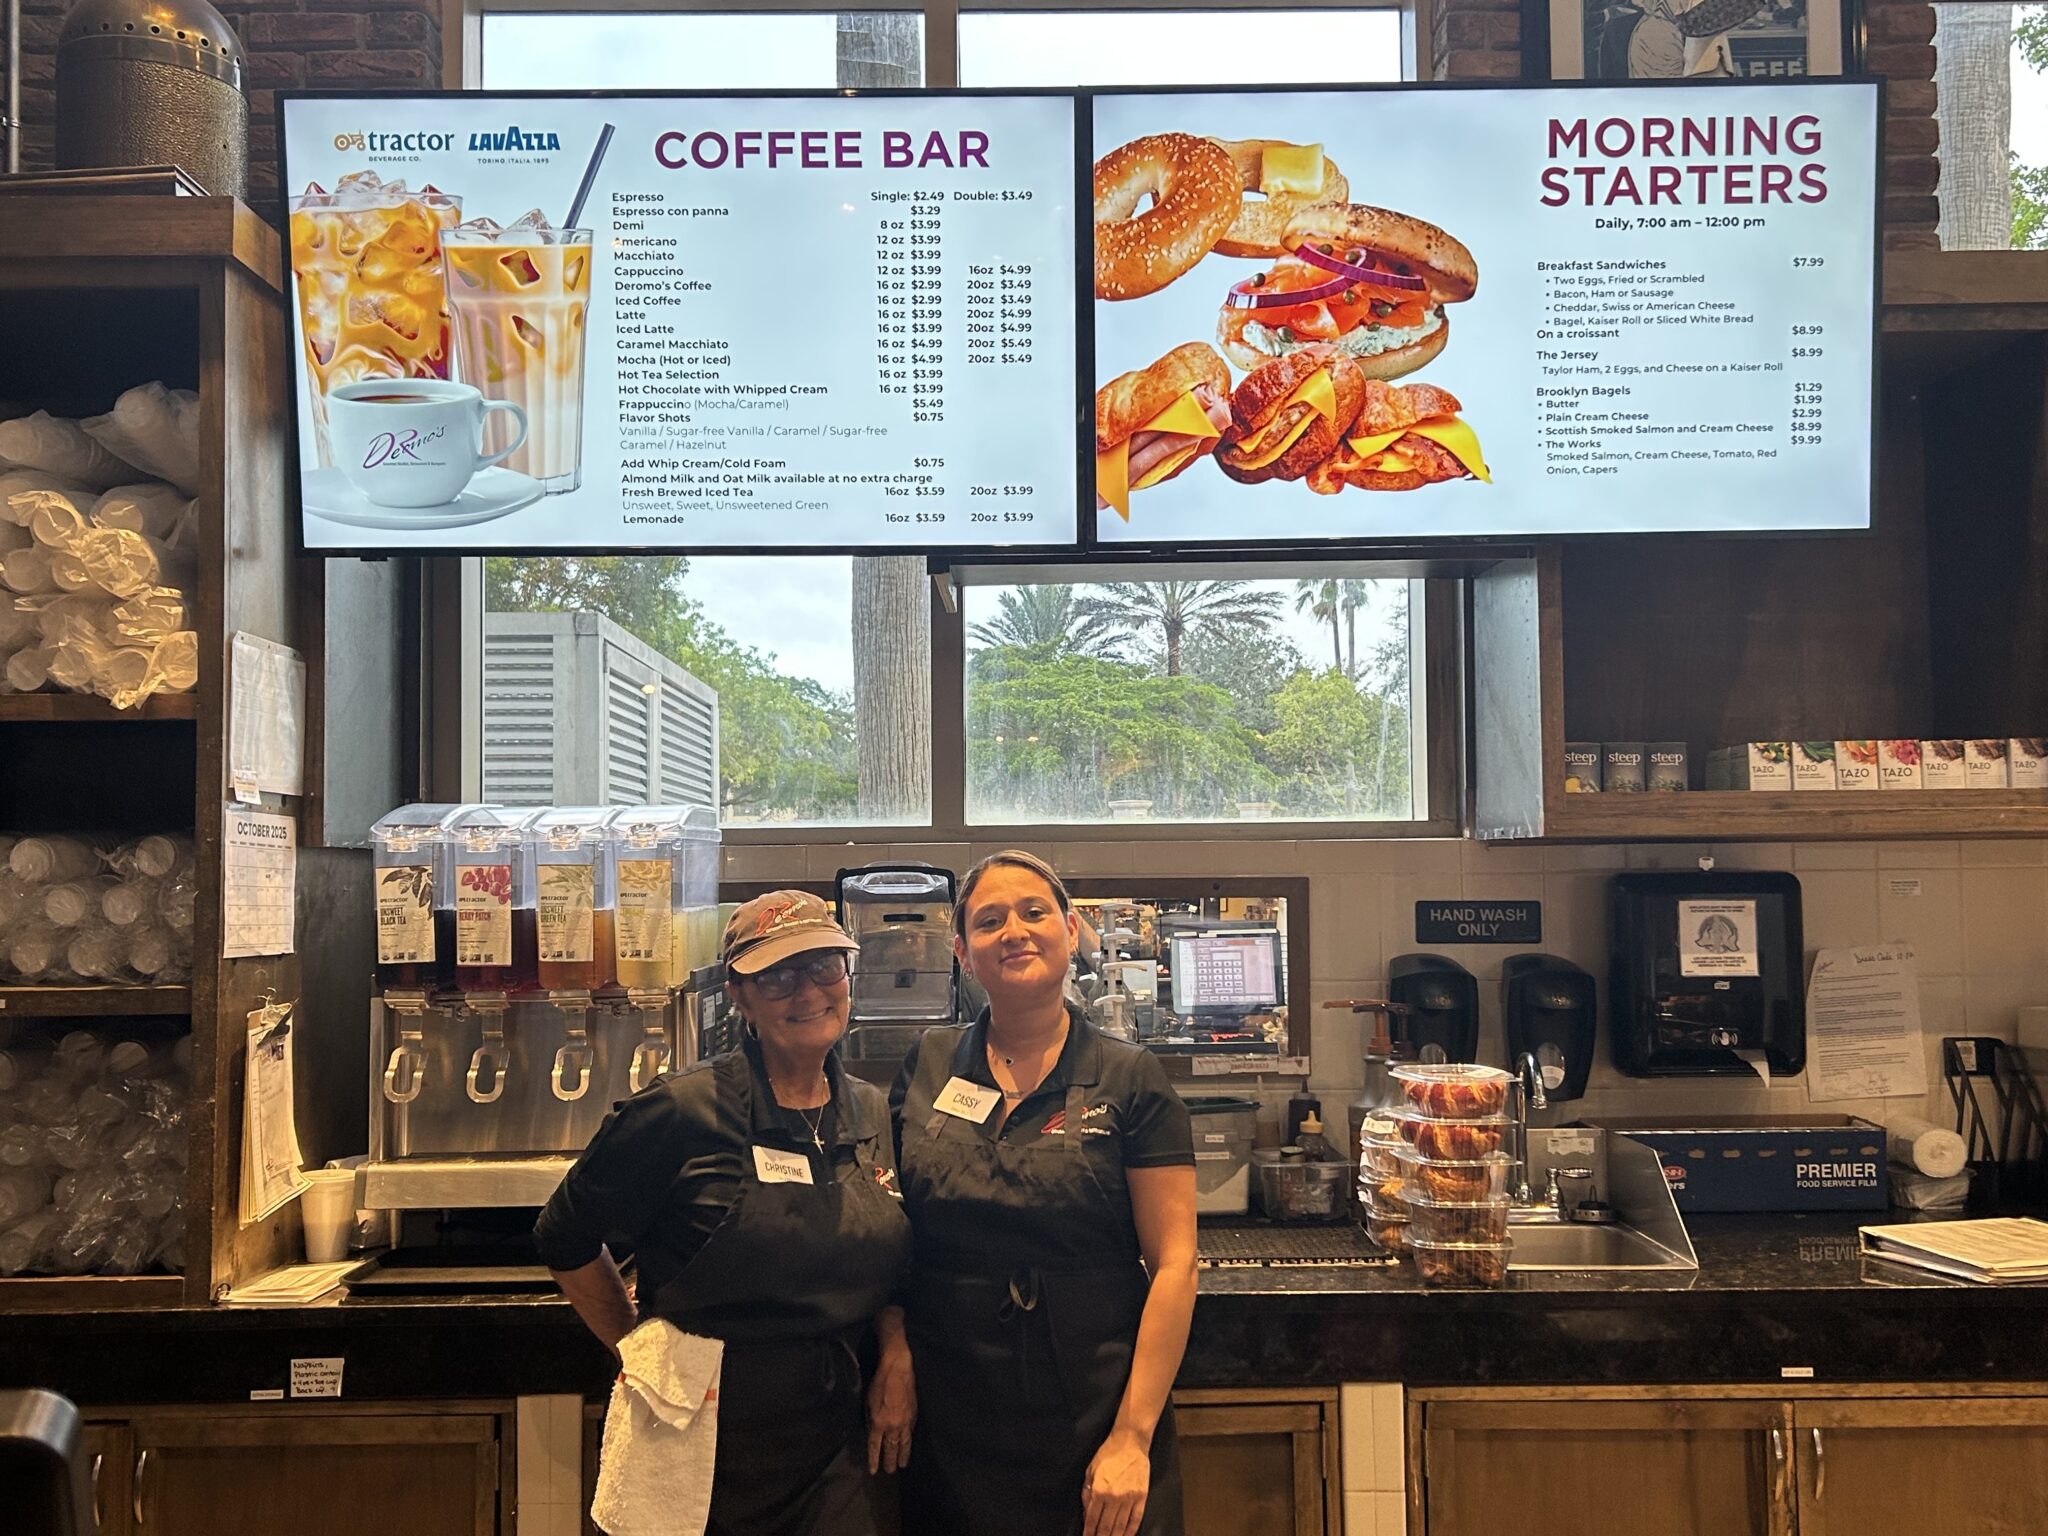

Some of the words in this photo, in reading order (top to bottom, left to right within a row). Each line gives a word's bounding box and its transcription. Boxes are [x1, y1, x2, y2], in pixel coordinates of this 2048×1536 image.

[367, 130, 455, 152] tractor
[468, 126, 561, 151] LAVAZZA
[1548, 115, 1822, 158] MORNING
[655, 131, 862, 169] COFFEE
[883, 131, 990, 168] BAR
[1539, 163, 1828, 207] STARTERS
[613, 193, 664, 203] Espresso
[871, 192, 910, 202] Single:
[914, 192, 944, 201] $2.49
[954, 191, 998, 200] Double:
[1002, 191, 1032, 200] $3.49
[613, 207, 664, 217] Espresso
[693, 208, 728, 217] panna
[911, 206, 940, 215] $3.29
[613, 221, 643, 230] Demi
[881, 221, 887, 229] 8
[910, 220, 940, 229] $3.99
[1595, 218, 1633, 230] Daily,
[1637, 218, 1666, 228] 7:00
[1670, 219, 1691, 227] am
[1705, 217, 1738, 227] 12:00
[1743, 219, 1765, 230] pm
[877, 236, 888, 244] 12
[910, 235, 941, 244] $3.99
[614, 251, 674, 260] Macchiato
[877, 251, 888, 259] 12
[911, 250, 941, 260] $3.99
[1537, 260, 1593, 270] Breakfast
[1597, 259, 1666, 270] Sandwiches
[1793, 257, 1824, 268] $7.99
[615, 267, 683, 277] Cappuccino
[877, 266, 888, 274] 12
[911, 266, 941, 275] $3.99
[969, 266, 993, 274] 16oz
[1000, 265, 1031, 275] $4.99
[615, 282, 670, 290] Deromo's
[674, 281, 712, 290] Coffee
[877, 281, 888, 289] 16
[911, 281, 941, 290] $2.99
[967, 280, 994, 289] 20oz
[1001, 280, 1031, 289] $3.49
[1553, 276, 1575, 285] Two
[1578, 276, 1605, 287] Eggs,
[1608, 275, 1633, 284] Fried
[1650, 274, 1704, 284] Scrambled
[1554, 290, 1588, 300] Bacon,
[1591, 289, 1615, 298] Ham
[1631, 288, 1673, 300] Sausage
[1537, 330, 1552, 339] On
[1567, 328, 1619, 339] croissant
[1792, 325, 1823, 336] $8.99
[1536, 350, 1557, 360] The
[1561, 350, 1598, 362] Jersey
[1792, 348, 1823, 357] $8.99
[1537, 387, 1588, 398] Brooklyn
[1592, 386, 1630, 398] Bagels
[1795, 383, 1822, 392] $1.29
[619, 400, 691, 410] Frappuccino
[694, 398, 789, 410] (Mocha/Caramel)
[913, 398, 943, 409] $5.49
[1546, 400, 1579, 408] Butter
[1794, 395, 1822, 405] $1.99
[620, 413, 655, 423] Flavor
[658, 413, 690, 423] Shots
[913, 412, 943, 422] $0.75
[1546, 413, 1572, 422] Plain
[1574, 412, 1608, 421] Cream
[1611, 412, 1649, 421] Cheese
[1792, 408, 1822, 418] $2.99
[1546, 440, 1564, 449] The
[1568, 439, 1601, 448] Works
[1791, 435, 1821, 445] $9.99
[621, 459, 644, 468] Add
[648, 459, 678, 471] Whip
[682, 458, 750, 469] Cream/Cold
[754, 459, 785, 468] Foam
[914, 458, 944, 468] $0.75
[622, 488, 654, 497] Fresh
[658, 488, 701, 497] Brewed
[706, 488, 729, 497] Iced
[733, 488, 753, 497] Tea
[885, 487, 909, 496] 16oz
[916, 487, 944, 496] $3.59
[970, 487, 997, 495] 20oz
[1004, 486, 1033, 496] $3.99
[623, 501, 673, 511] Unsweet,
[677, 501, 713, 511] Sweet,
[716, 500, 792, 510] Unsweetened
[795, 500, 828, 510] Green
[623, 515, 684, 524] Lemonade
[885, 514, 909, 522] 16oz
[916, 513, 945, 523] $3.59
[971, 513, 997, 522] 20oz
[1004, 513, 1033, 522] $3.99
[1564, 752, 1597, 766] steep
[1608, 752, 1641, 766] steep
[1651, 752, 1684, 766] steep
[2014, 760, 2037, 769] TAZO
[1752, 766, 1775, 774] TAZO
[1796, 764, 1818, 772] TAZO
[1926, 763, 1949, 771] TAZO
[1968, 762, 1991, 770] TAZO
[1840, 768, 1870, 778] TAZO
[1882, 768, 1912, 778] TAZO
[238, 822, 270, 838] OCTOBER
[271, 825, 288, 840] 2025
[1430, 908, 1476, 921] HAND
[1480, 908, 1526, 920] WASH
[1458, 924, 1500, 936] ONLY
[952, 1093, 982, 1109] CASSY
[764, 1161, 804, 1178] CHRISTINE
[1796, 1163, 1876, 1178] PREMIER
[1797, 1180, 1820, 1188] FOOD
[1822, 1180, 1856, 1188] SERVICE
[1858, 1179, 1878, 1187] FILM
